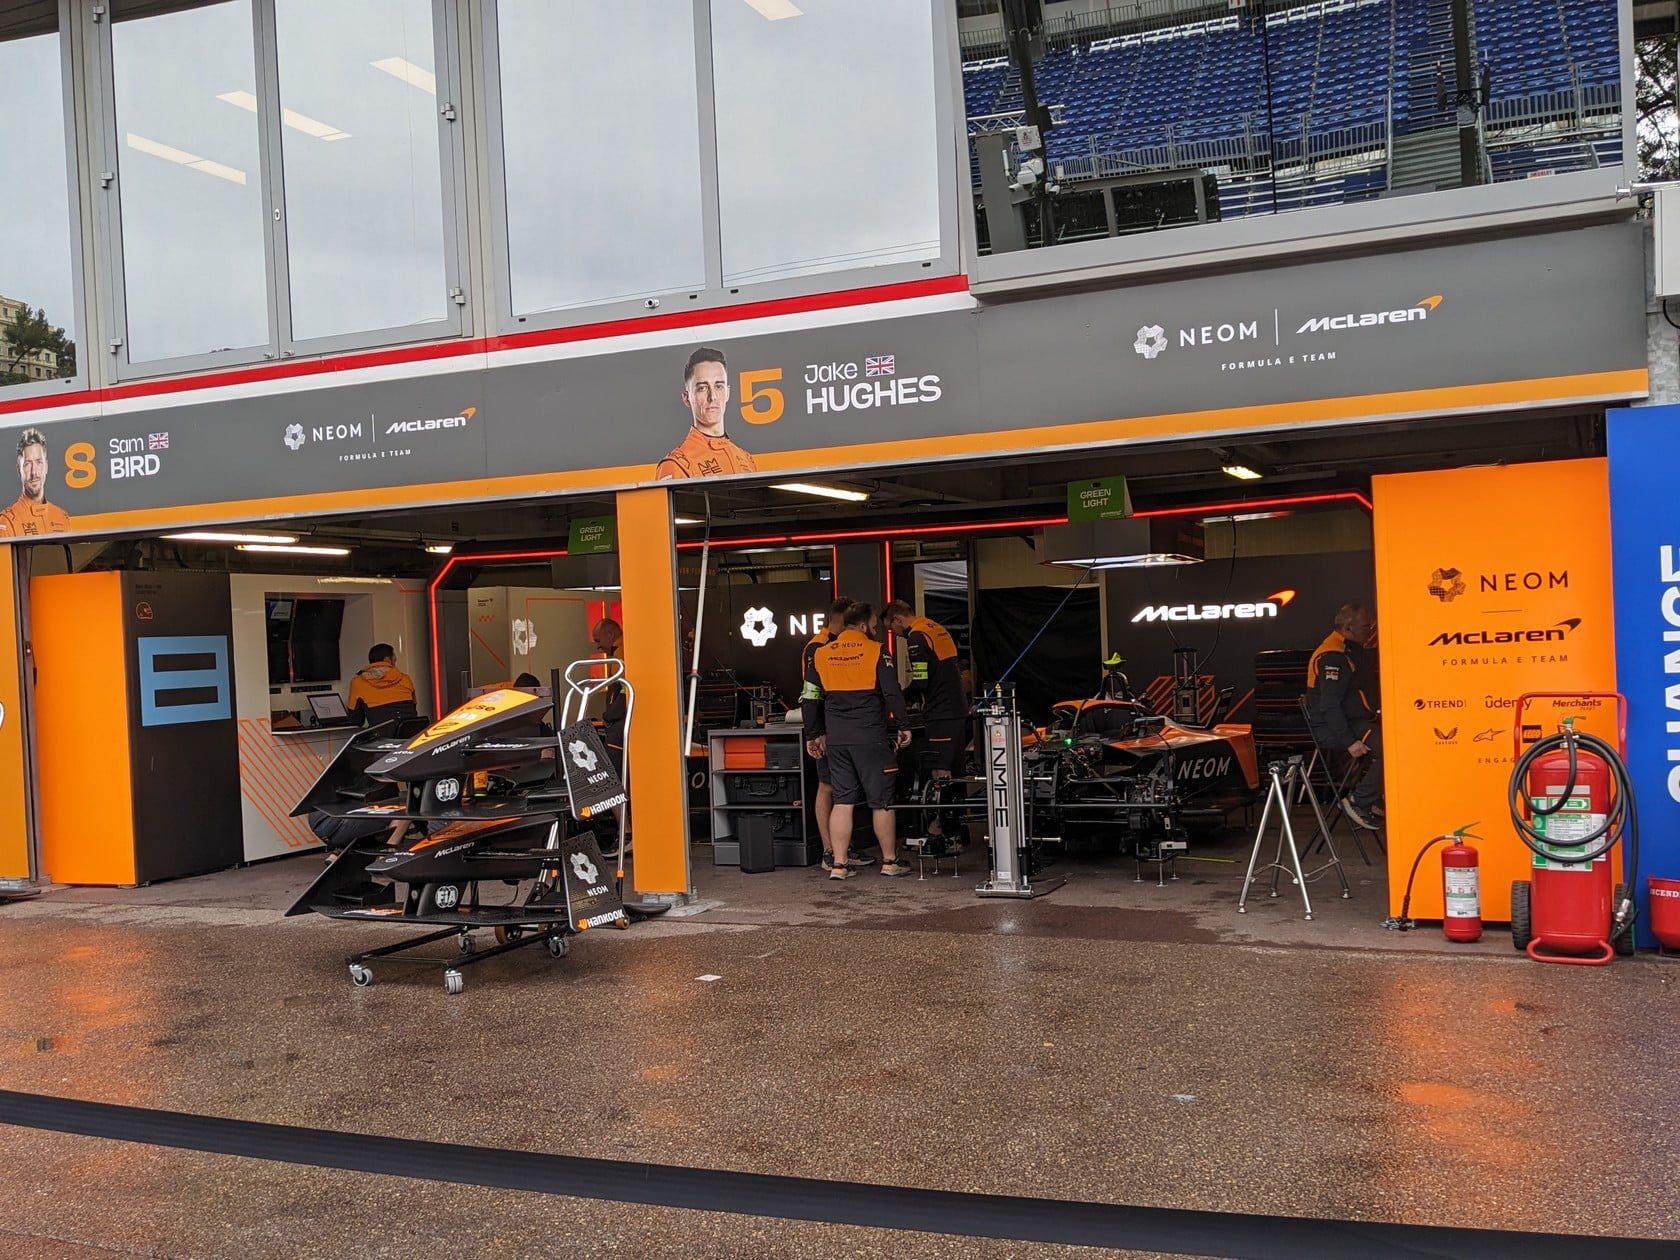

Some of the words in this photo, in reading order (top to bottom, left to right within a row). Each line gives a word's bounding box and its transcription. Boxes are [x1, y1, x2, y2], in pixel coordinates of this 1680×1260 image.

[1179, 321, 1258, 347] NEOM
[1296, 305, 1427, 334] McLaren
[1222, 357, 1281, 371] FORMULA
[1289, 356, 1295, 364] E
[1302, 352, 1337, 363] TEAM
[804, 362, 858, 384] Jake
[739, 367, 785, 425] 5
[806, 375, 942, 414] HUGHES
[312, 422, 362, 441] NEOM
[385, 415, 467, 435] McLaren
[109, 437, 144, 455] Sam
[339, 452, 377, 462] FORMULA
[389, 449, 411, 458] TEAM
[64, 442, 97, 489] 8
[110, 454, 161, 480] BIRD
[1080, 488, 1112, 499] GREEN
[1082, 498, 1109, 508] LIGHT
[579, 525, 605, 534] GREEN
[580, 533, 602, 542] LIGHT
[1480, 570, 1569, 592] NEOM
[1130, 601, 1278, 623] McLaren
[789, 613, 825, 635] NE
[1428, 626, 1566, 646] McLaren
[1442, 657, 1508, 666] FORMULA
[1517, 656, 1523, 664] E
[1532, 655, 1569, 663] TEAM
[1426, 699, 1464, 709] TREND
[1552, 698, 1602, 708] Merchants
[432, 735, 471, 756] McLaren
[587, 770, 610, 785] NEOM
[1177, 756, 1231, 780] NEOM
[993, 747, 1009, 828] NMFE
[434, 841, 475, 858] McLaren
[587, 885, 609, 897] NEOM
